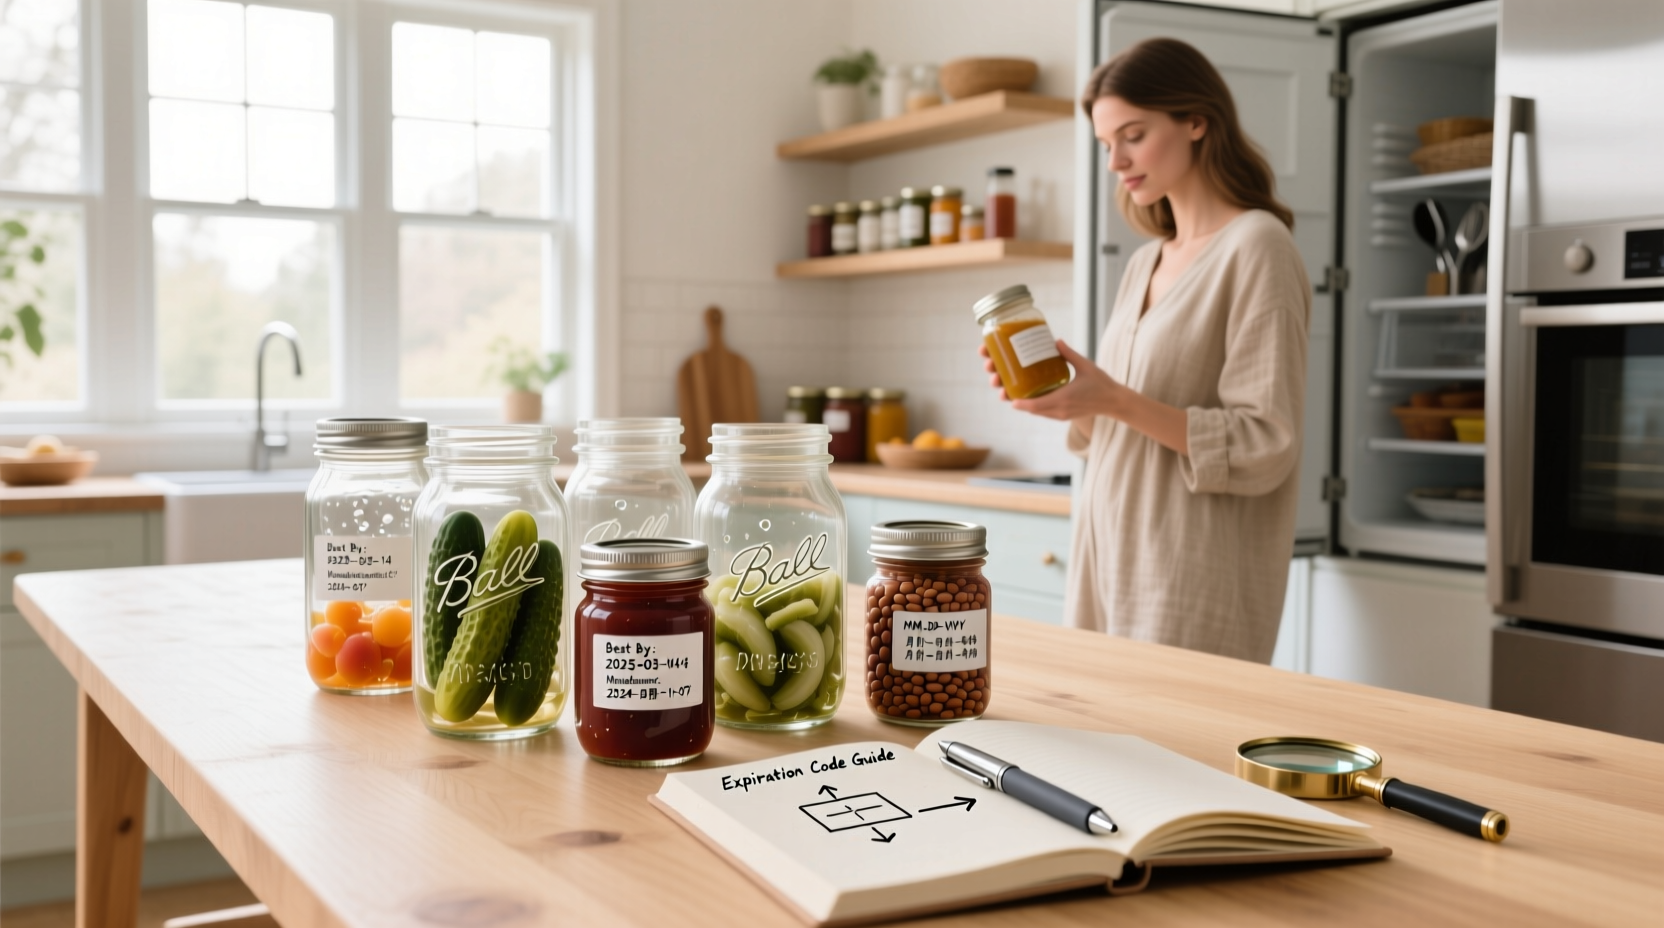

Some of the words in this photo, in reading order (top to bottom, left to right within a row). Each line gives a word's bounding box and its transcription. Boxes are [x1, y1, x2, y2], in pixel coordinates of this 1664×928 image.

[434, 542, 545, 615] Ball
[730, 532, 831, 605] Ball
[605, 641, 632, 654] Best
[636, 642, 656, 657] By:
[721, 767, 804, 792] Expiration
[810, 755, 847, 774] Code
[851, 747, 896, 767] Guide
